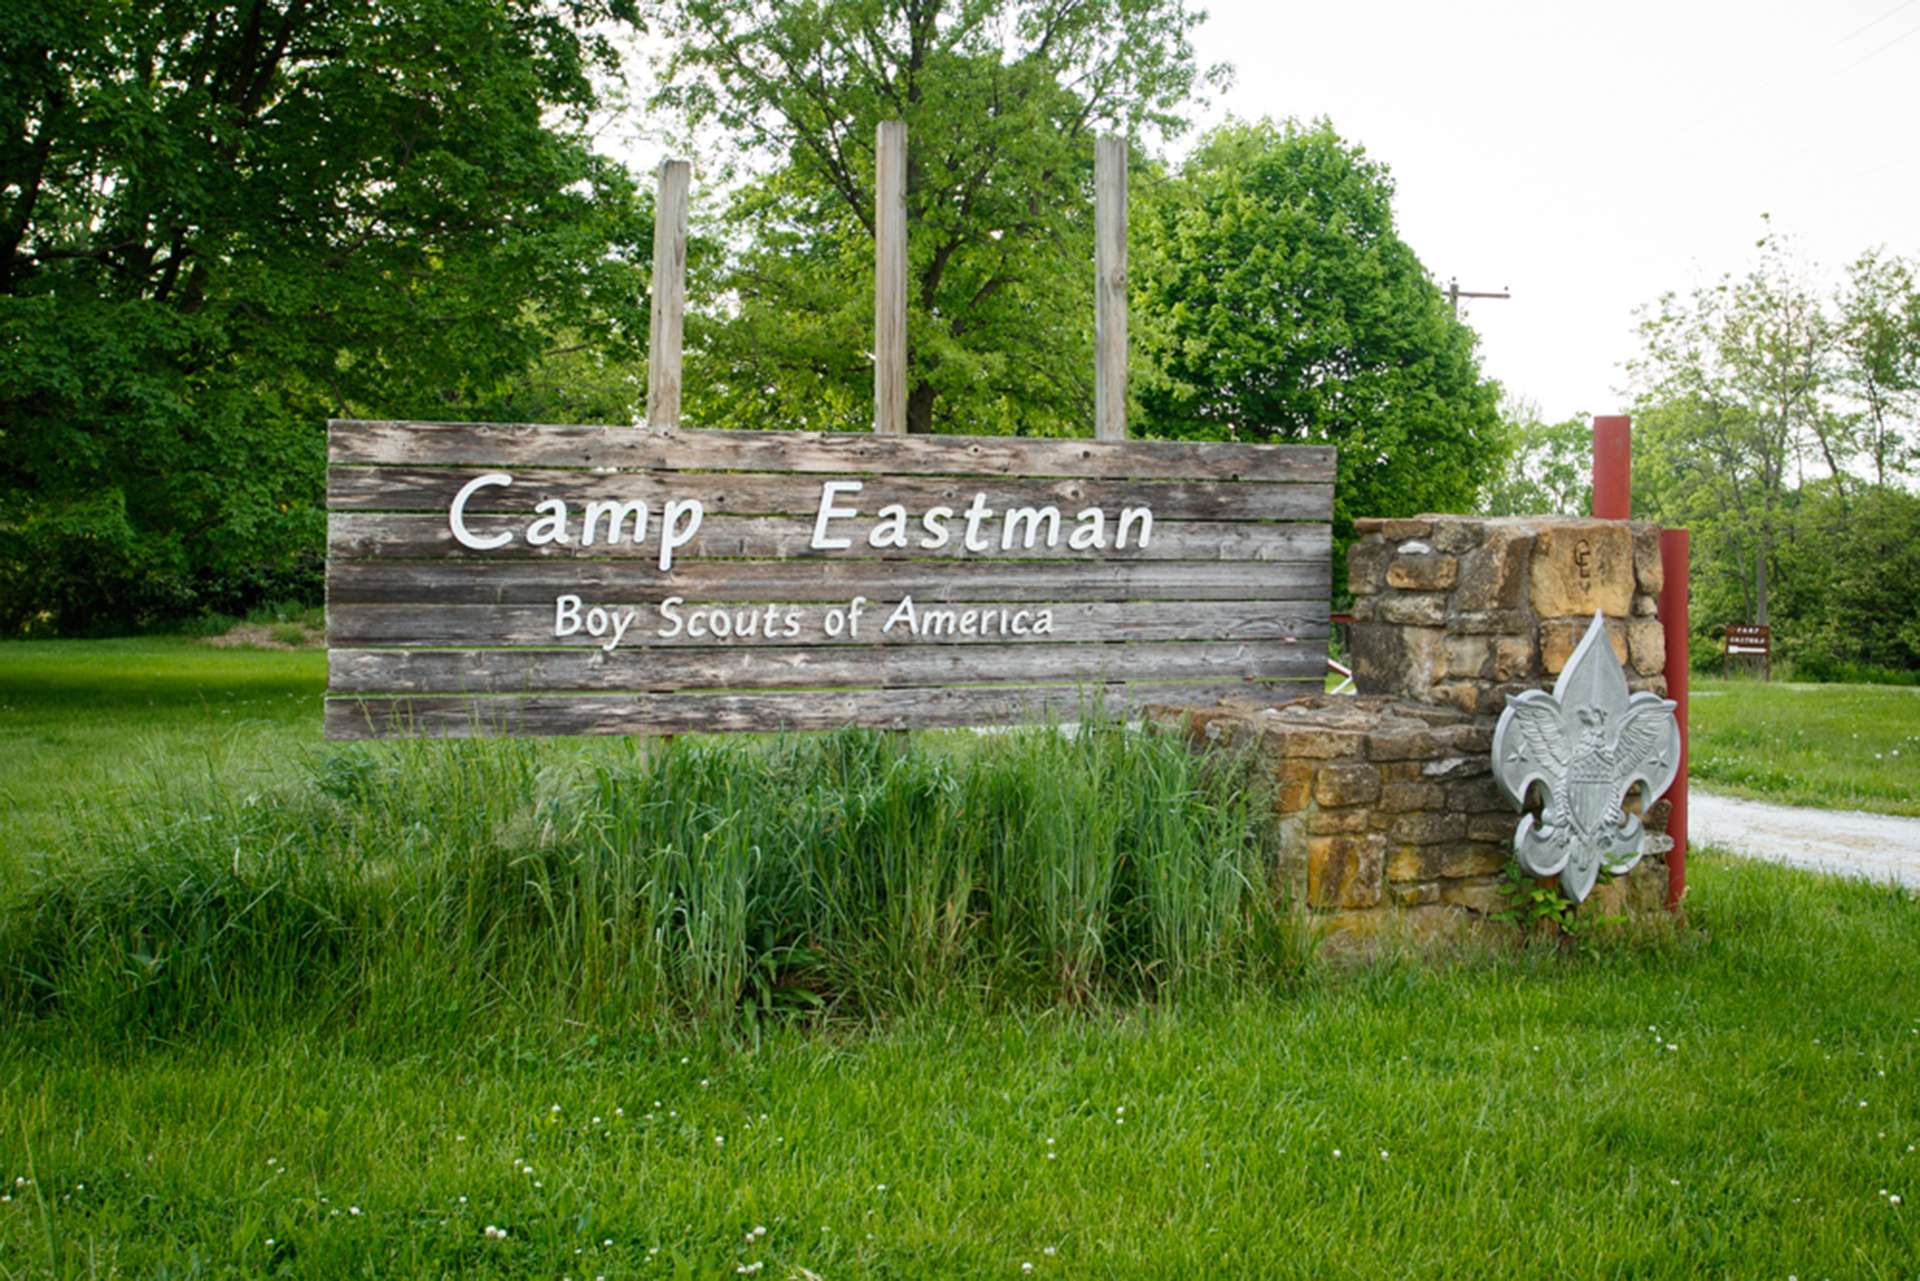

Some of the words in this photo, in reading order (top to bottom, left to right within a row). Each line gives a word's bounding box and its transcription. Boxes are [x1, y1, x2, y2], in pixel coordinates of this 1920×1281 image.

[450, 473, 703, 571] Camp
[810, 480, 1154, 551] Eastman
[555, 594, 635, 651] Boy
[658, 597, 802, 638] Scouts
[824, 597, 866, 637] of
[882, 595, 1055, 636] America
